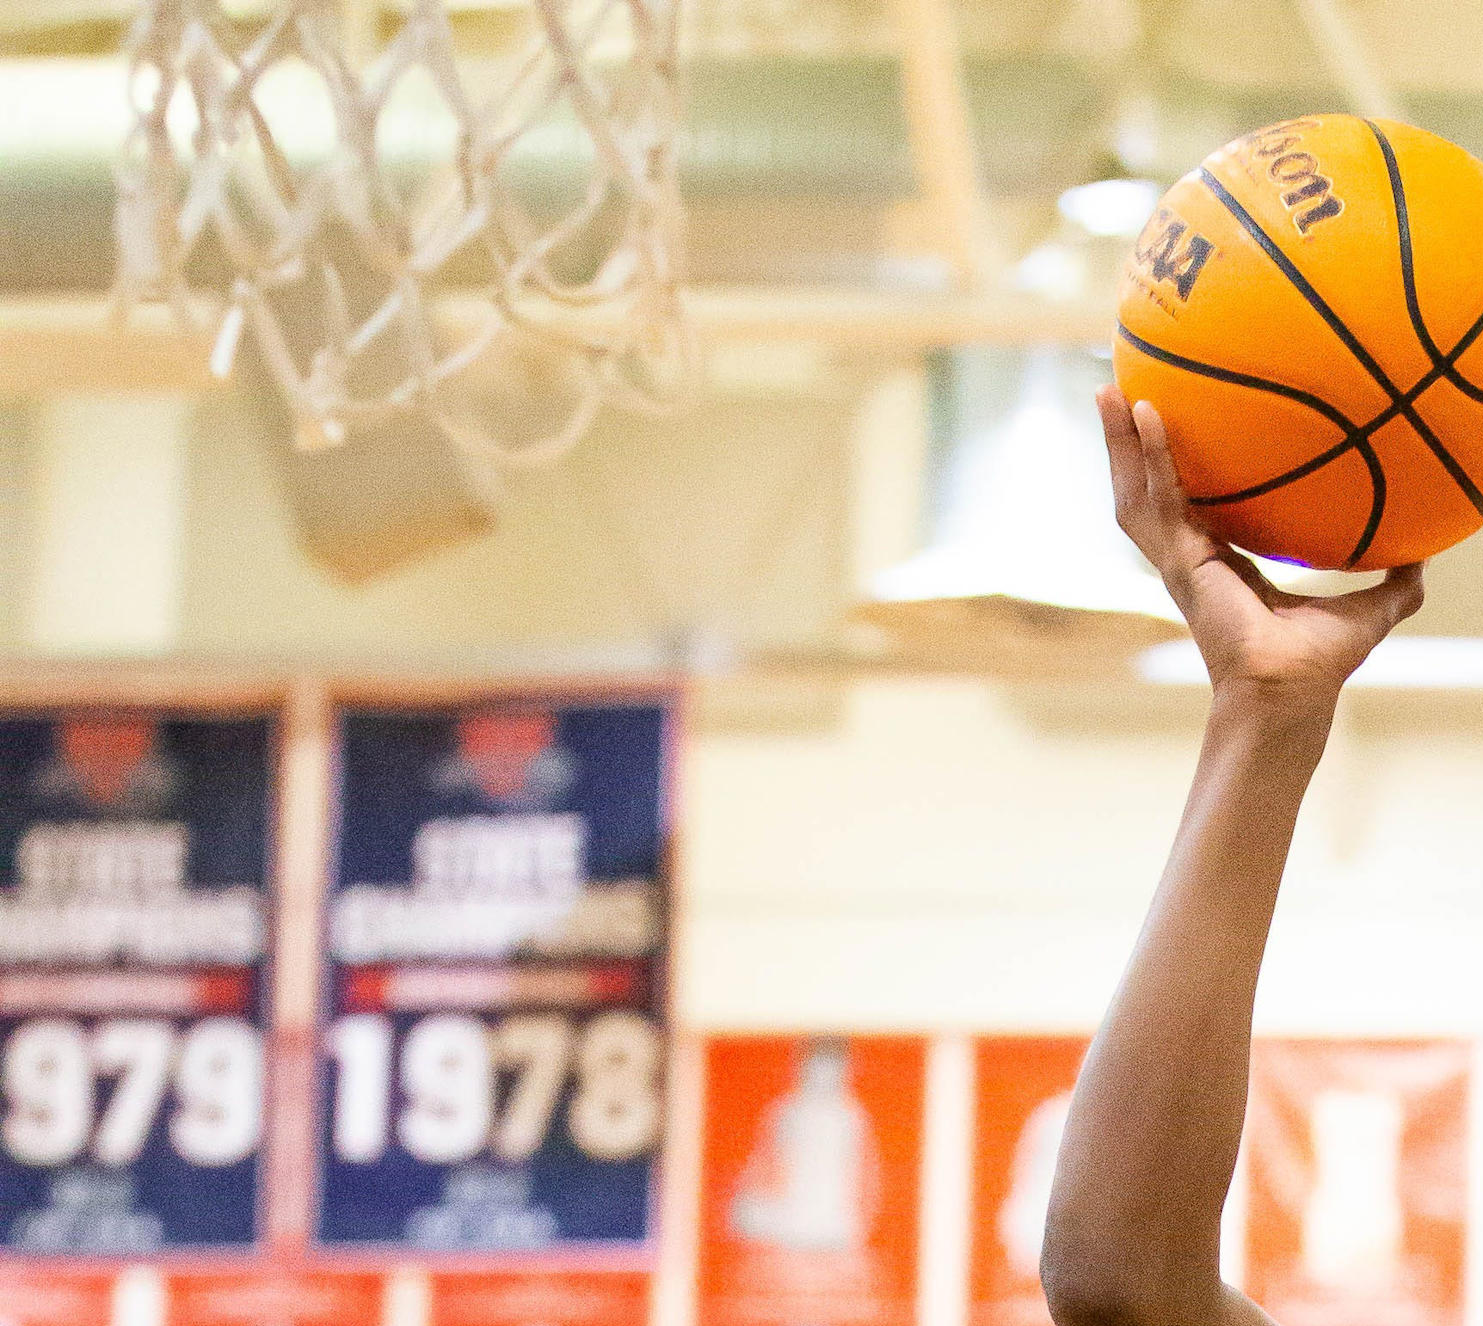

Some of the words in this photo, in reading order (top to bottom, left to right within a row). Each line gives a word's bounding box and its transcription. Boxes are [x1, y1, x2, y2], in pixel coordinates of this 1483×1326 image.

[1250, 119, 1345, 236] lson
[0, 1010, 263, 1168] 979
[326, 1008, 662, 1166] 1978
